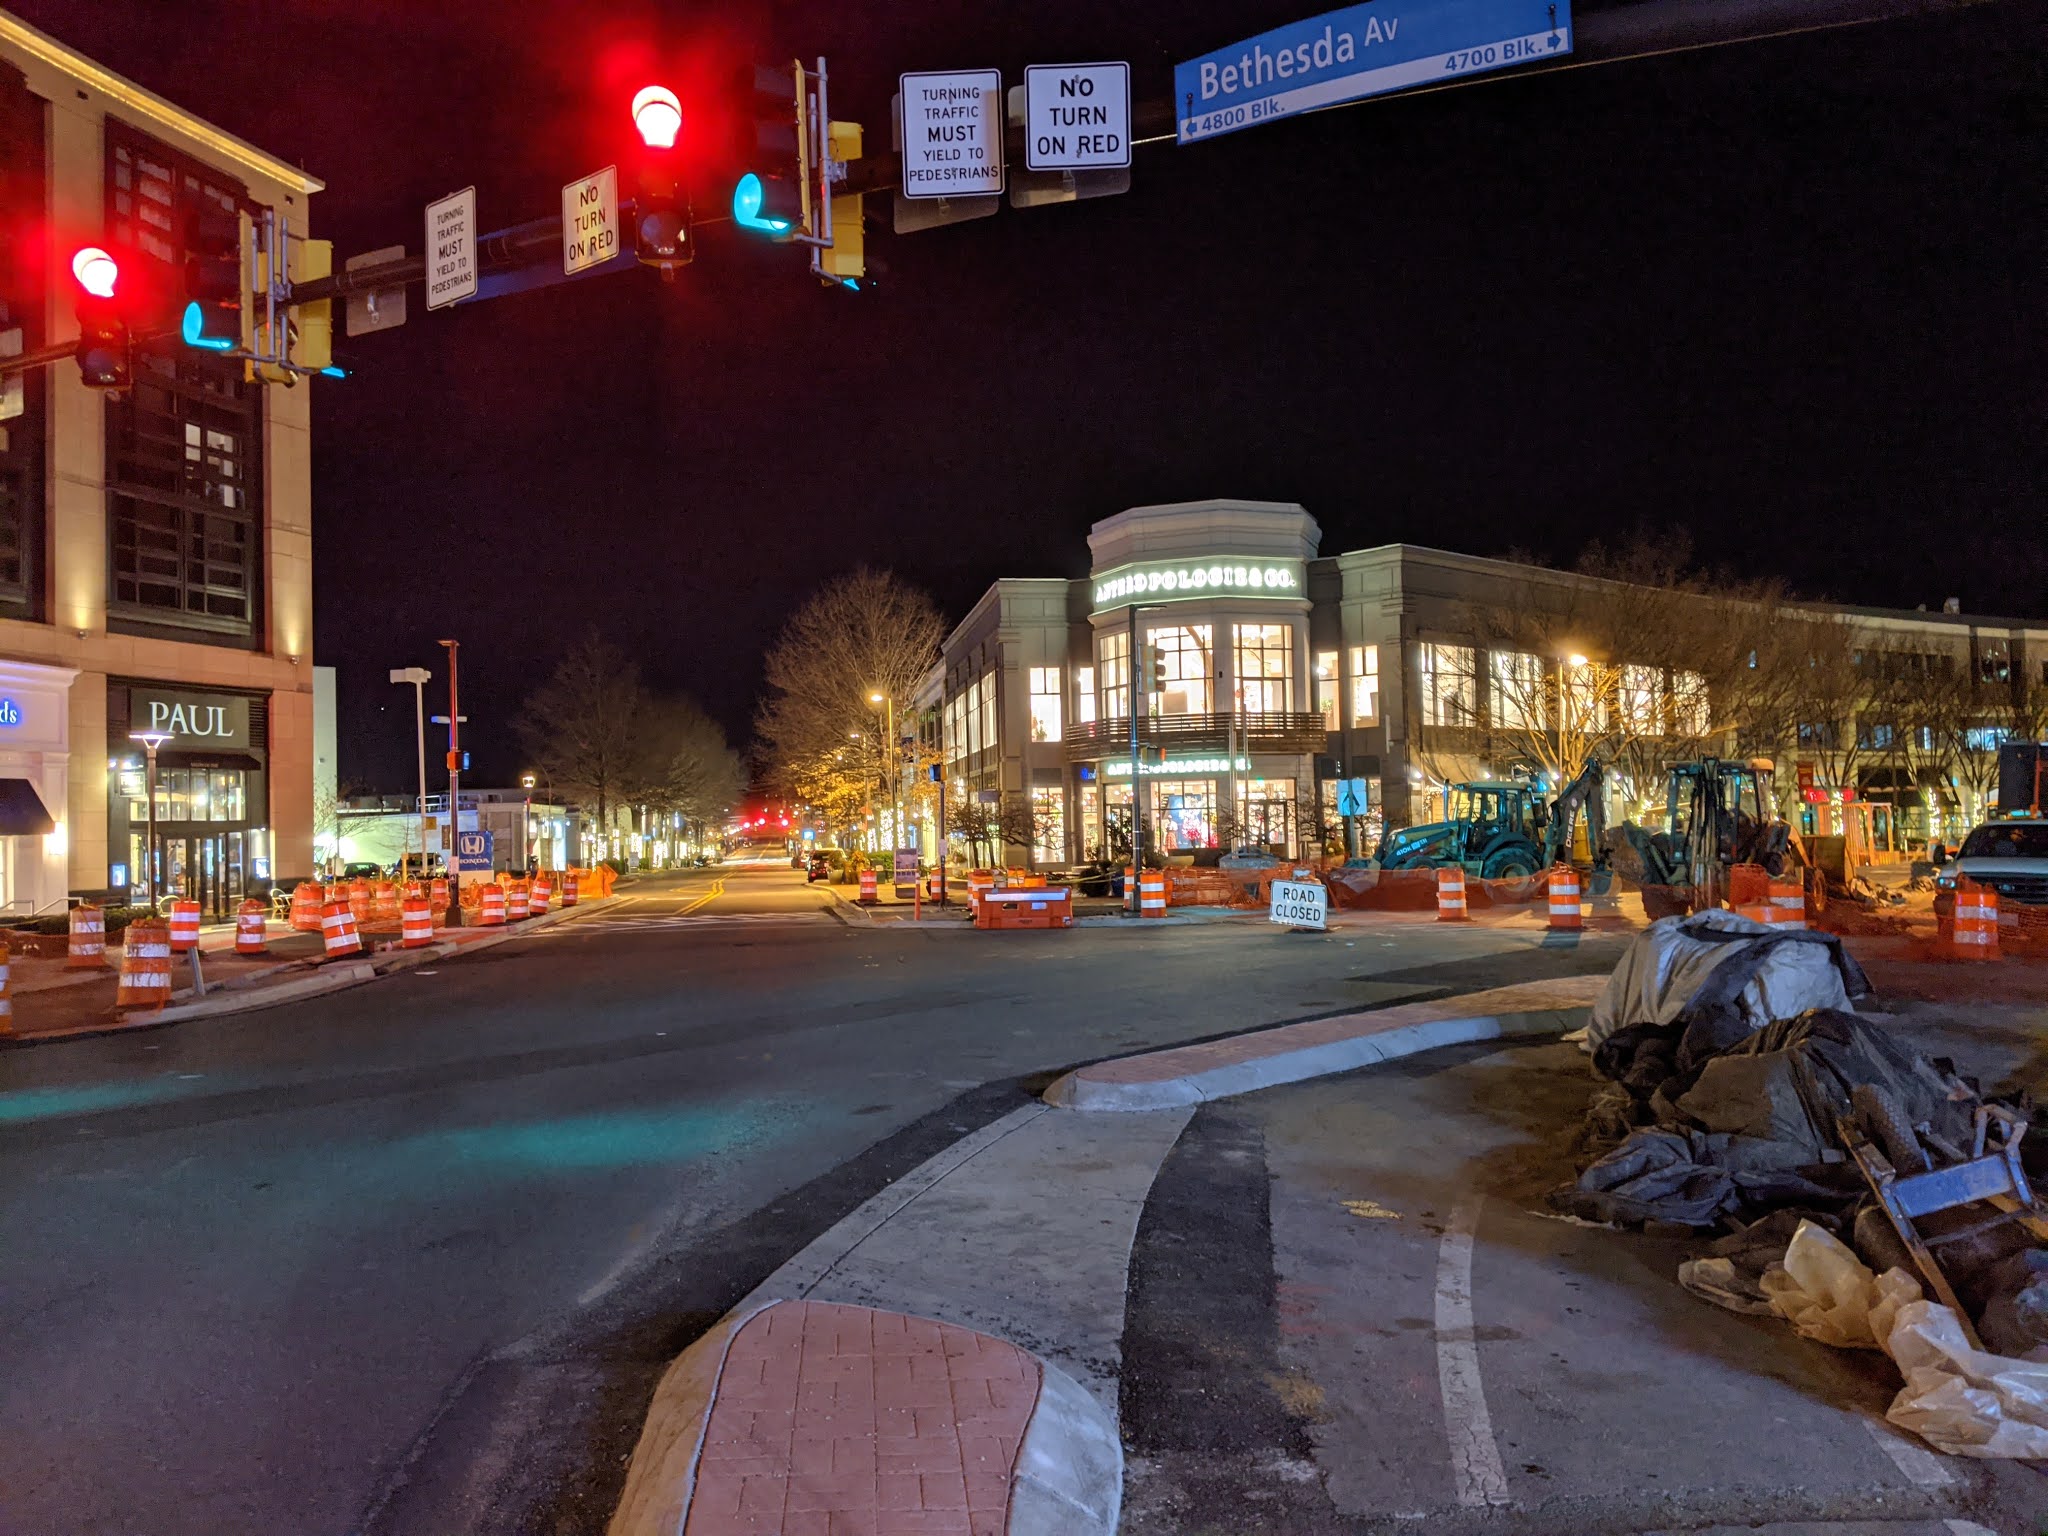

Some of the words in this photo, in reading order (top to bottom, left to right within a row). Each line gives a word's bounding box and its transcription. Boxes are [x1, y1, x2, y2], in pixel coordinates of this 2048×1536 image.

[1200, 25, 1355, 100] Bethesda
[1364, 16, 1398, 47] Av
[1445, 47, 1496, 71] 4700
[1503, 38, 1542, 60] Blk.
[922, 87, 980, 101] TURNING
[1060, 78, 1094, 97] NO
[924, 106, 979, 120] TRAFFIC
[1049, 106, 1107, 126] TURN
[1202, 108, 1245, 132] 4800
[1251, 97, 1285, 120] Blk.
[928, 125, 976, 142] MUST
[923, 149, 960, 161] YIELD
[968, 147, 984, 159] TO
[1037, 136, 1065, 155] ON
[1078, 134, 1120, 153] RED
[909, 166, 999, 181] PEDESTRIANS
[580, 186, 598, 207] NO
[437, 205, 464, 226] TURNING
[575, 208, 606, 234] TURN
[437, 221, 465, 241] TRAFFIC
[438, 238, 463, 260] MUST
[569, 242, 585, 261] ON
[590, 230, 614, 252] RED
[436, 261, 456, 278] YIELD
[458, 257, 467, 269] TO
[431, 271, 472, 295] PEDESTRIANS
[149, 701, 234, 737] PAUL
[1566, 810, 1575, 848] DEERE
[1283, 888, 1315, 903] ROAD
[1276, 904, 1321, 921] CLOSED
